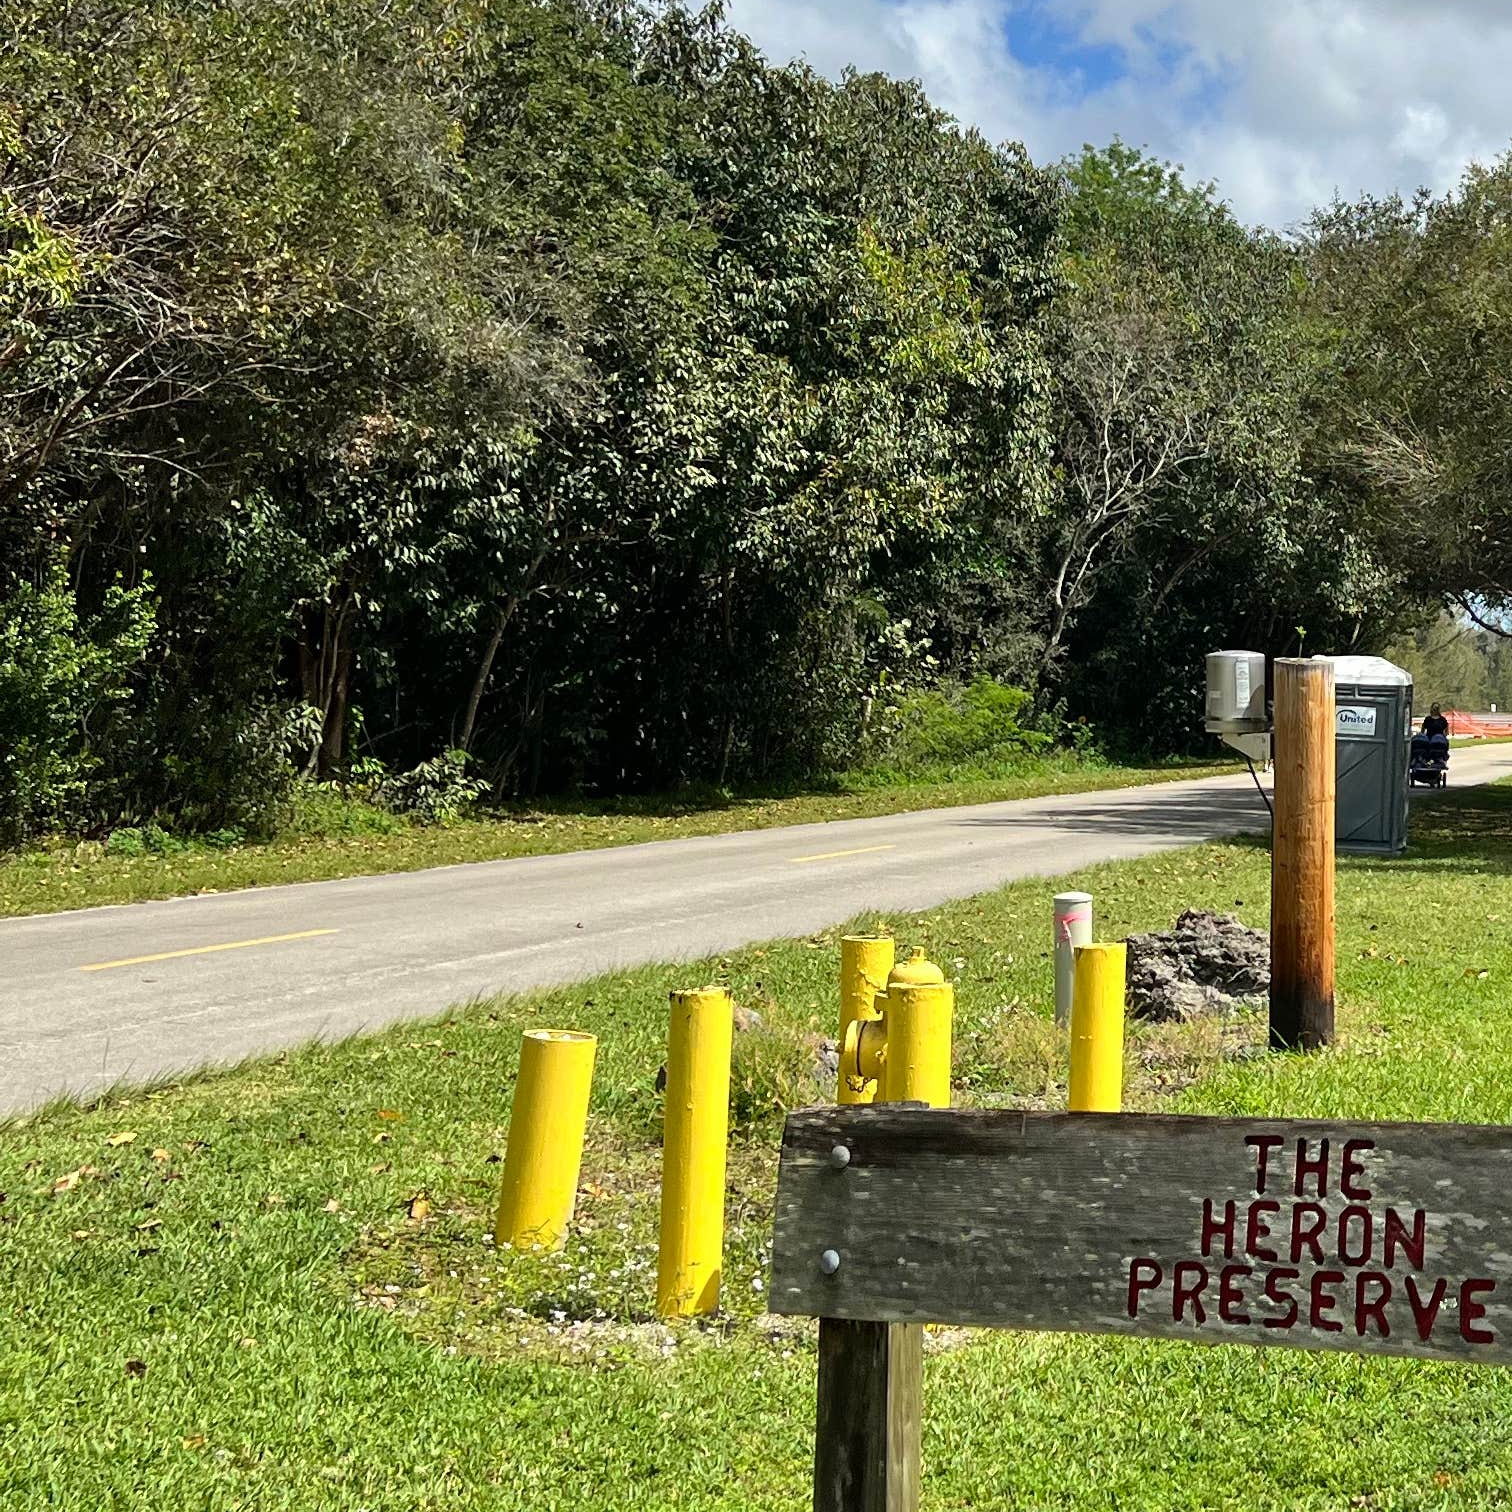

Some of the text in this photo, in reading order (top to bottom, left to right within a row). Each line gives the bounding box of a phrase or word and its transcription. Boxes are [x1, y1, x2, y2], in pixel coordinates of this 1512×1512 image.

[1244, 1134, 1376, 1201] THE
[1201, 1197, 1427, 1272] HERON
[1127, 1257, 1497, 1344] PRESERVE
